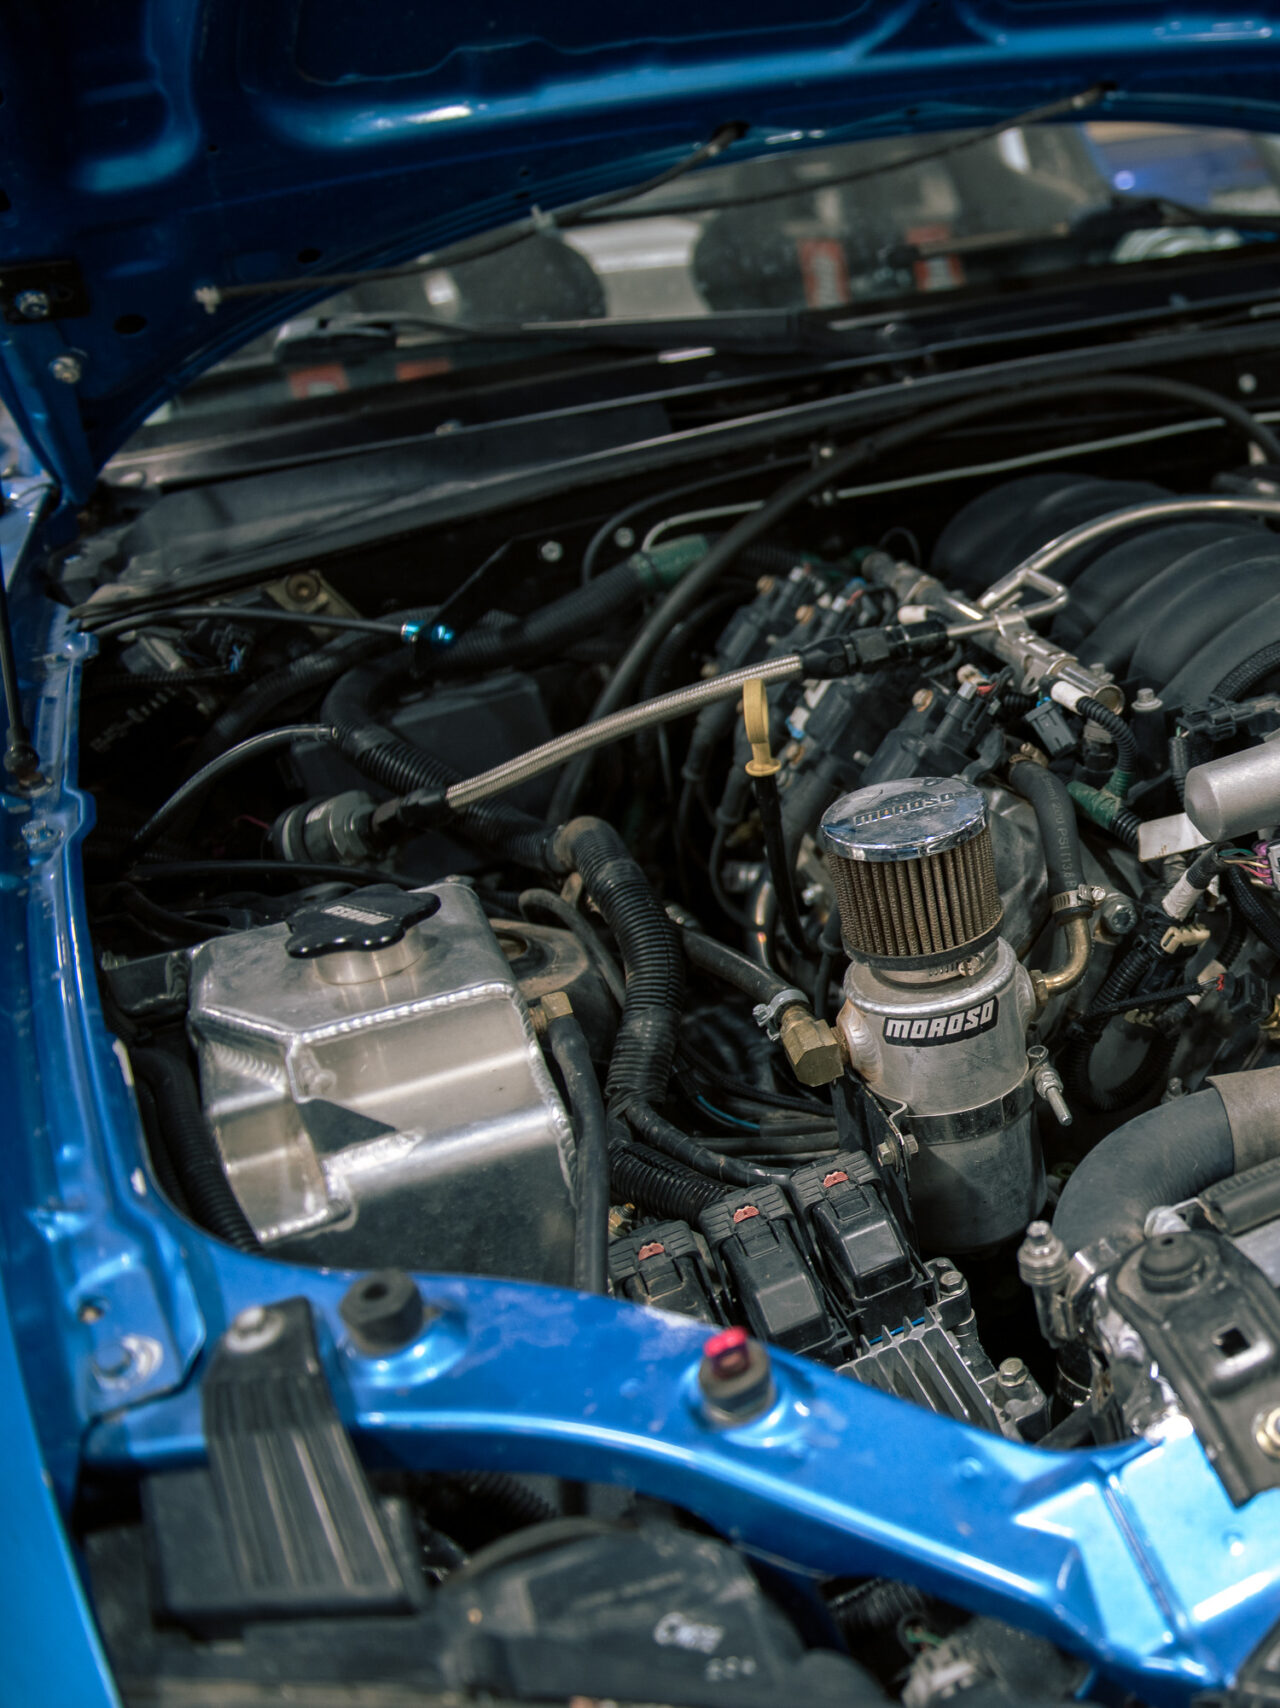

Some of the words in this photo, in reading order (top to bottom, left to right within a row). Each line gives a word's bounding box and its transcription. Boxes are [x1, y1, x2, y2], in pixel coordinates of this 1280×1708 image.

[852, 793, 956, 827] MOROSO
[1056, 827, 1071, 850] PSI
[884, 998, 996, 1039] MOROSO
